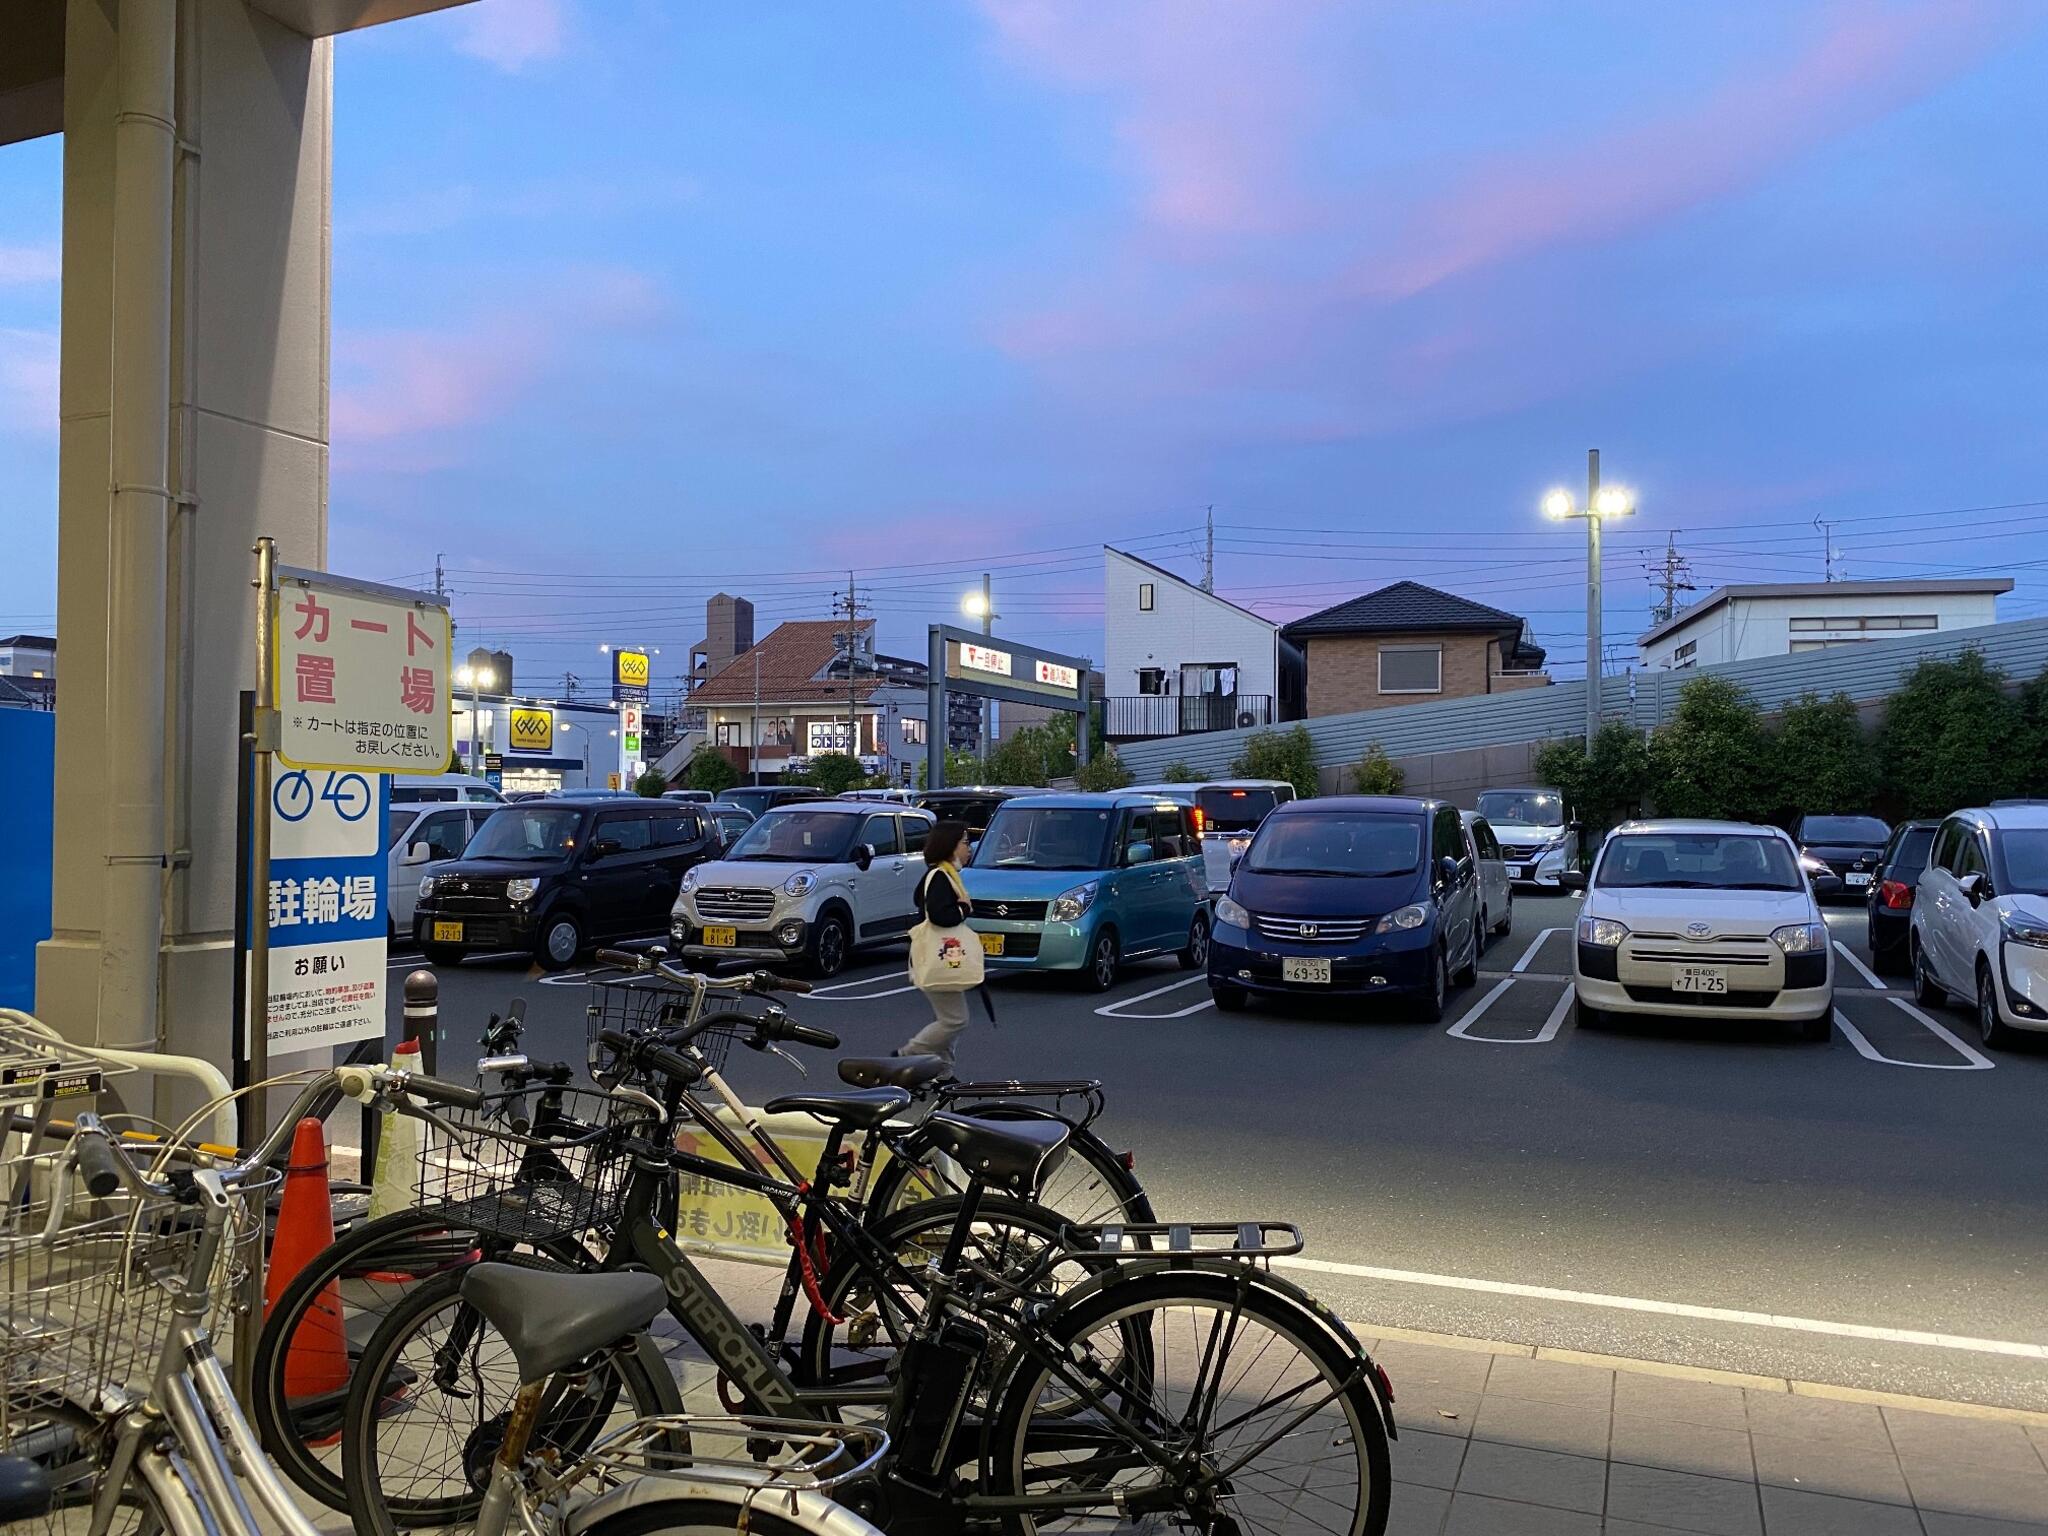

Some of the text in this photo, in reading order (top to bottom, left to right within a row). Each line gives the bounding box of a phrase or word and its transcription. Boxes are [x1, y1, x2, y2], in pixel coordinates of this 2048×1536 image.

[294, 594, 435, 656] カート
[621, 658, 646, 675] GEO
[296, 653, 435, 714] 置場
[293, 716, 429, 740] ※カートは指定の位置に
[515, 715, 548, 736] GEO
[627, 711, 636, 729] P
[356, 740, 440, 758] お戻しください。
[812, 737, 849, 747] のトラ
[268, 876, 377, 928] 駐輪場
[711, 935, 733, 945] 81-45
[294, 955, 345, 976] お願い
[1294, 968, 1328, 980] 69-35
[1684, 977, 1724, 991] 71-25
[761, 1185, 793, 1198] VACANZE
[664, 1267, 793, 1416] STEPCRUZ
